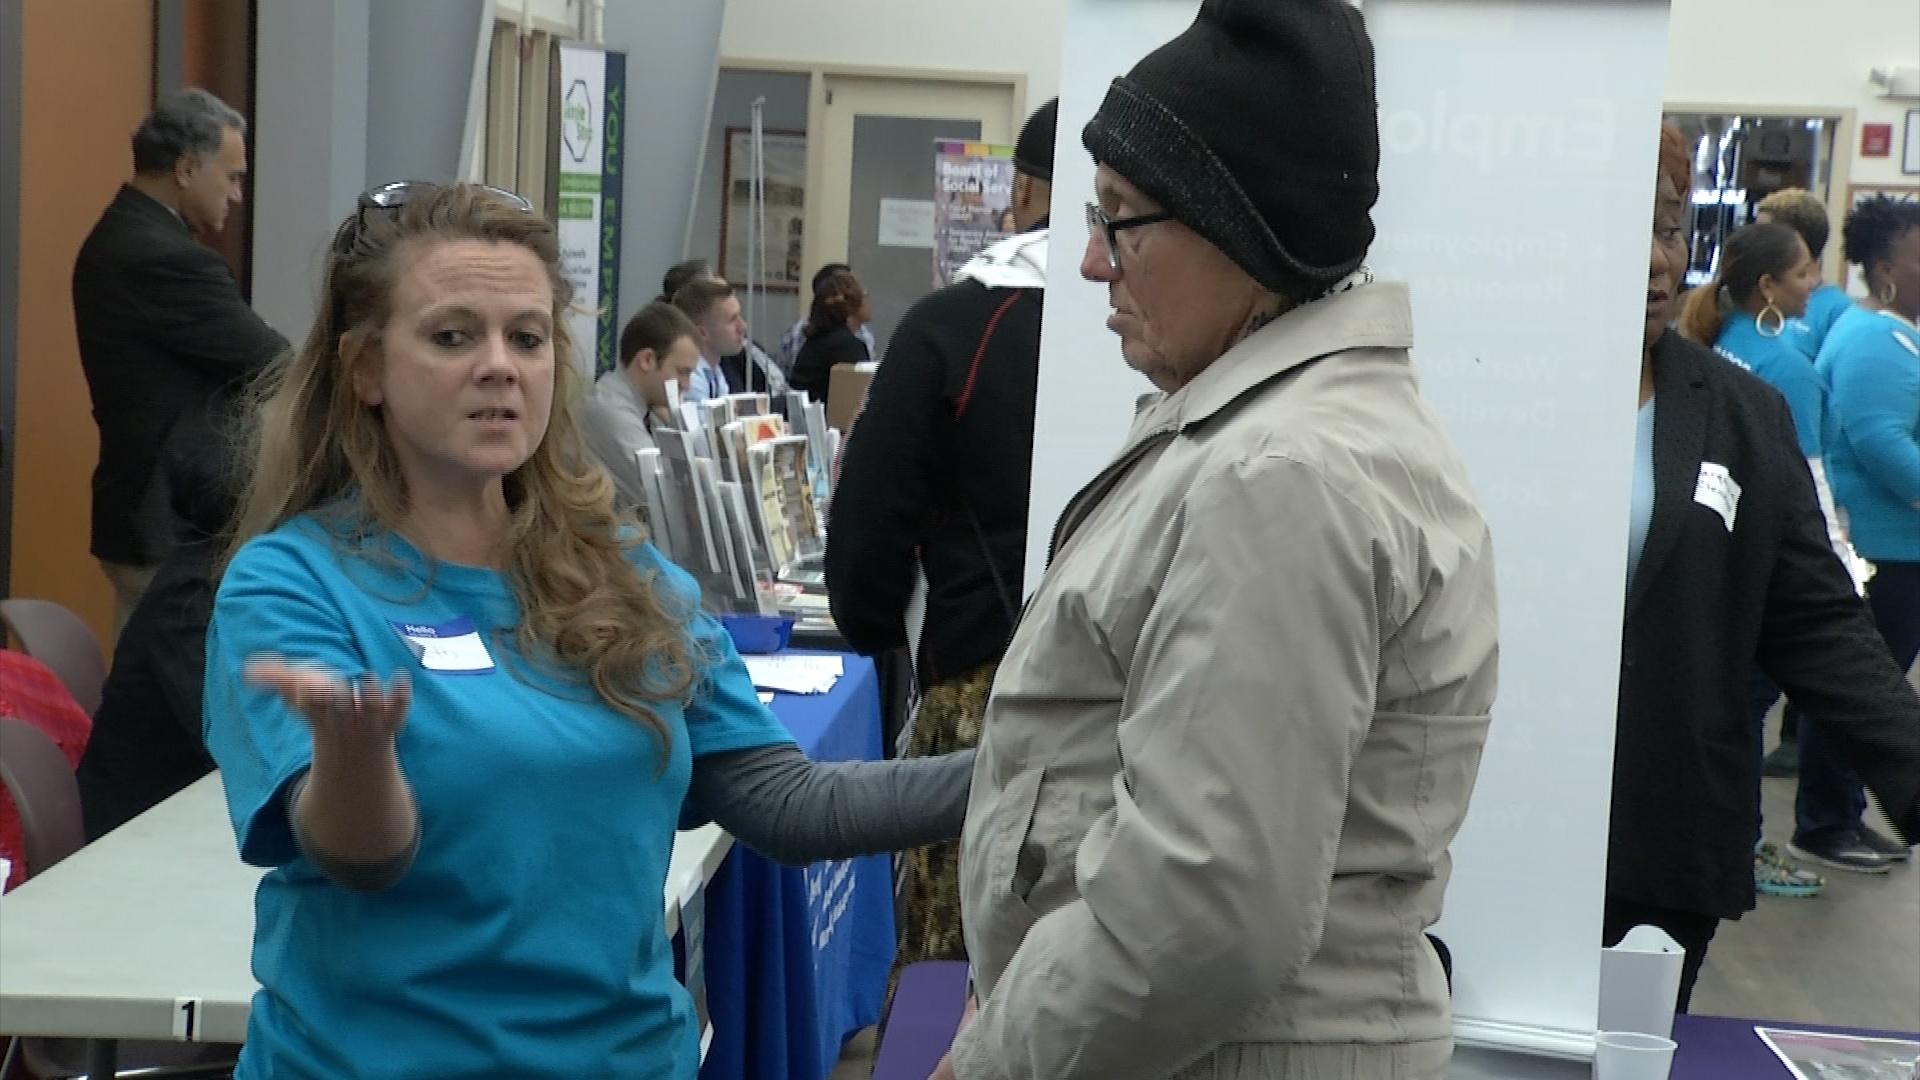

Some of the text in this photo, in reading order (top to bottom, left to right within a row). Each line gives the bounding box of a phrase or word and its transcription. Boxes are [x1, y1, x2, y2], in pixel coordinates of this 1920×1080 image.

[606, 85, 620, 175] YOU
[943, 161, 980, 177] Board
[943, 177, 980, 193] Social
[181, 1000, 195, 1040] 1
